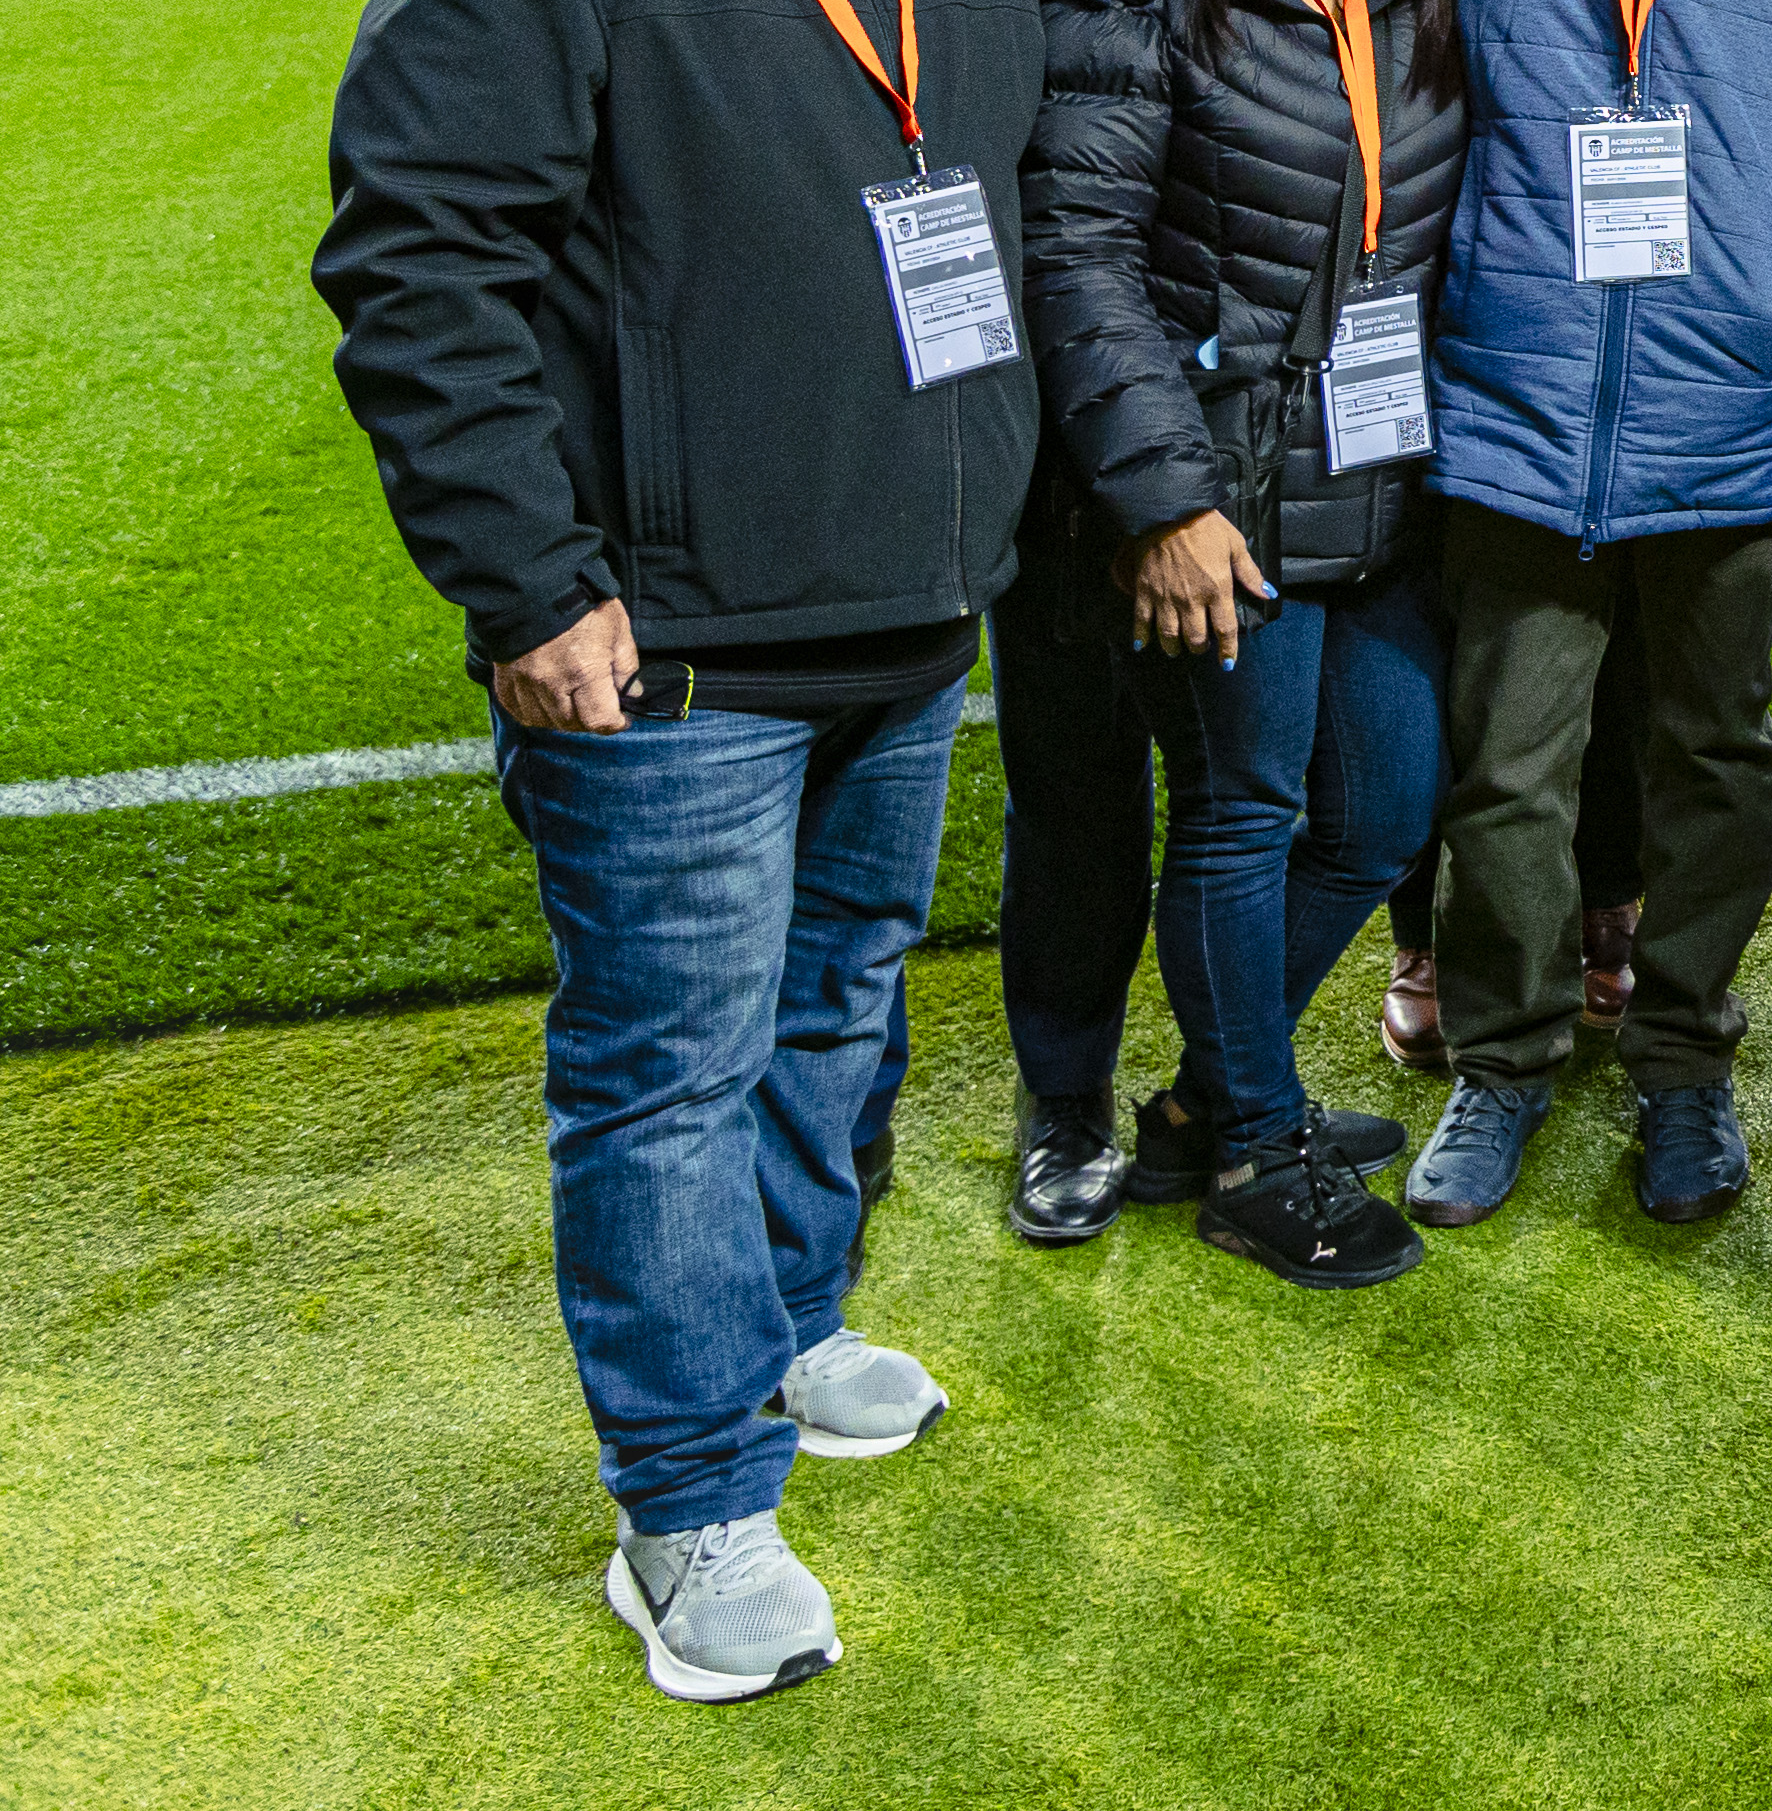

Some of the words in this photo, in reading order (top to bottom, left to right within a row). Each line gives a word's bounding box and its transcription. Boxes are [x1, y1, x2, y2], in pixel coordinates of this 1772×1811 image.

[1611, 147, 1633, 155] CAMP
[1634, 146, 1644, 154] DE
[1645, 144, 1682, 153] MESTALLA
[920, 221, 939, 232] CAMP
[940, 219, 950, 228] DE
[951, 210, 985, 226] MESTALLA
[1354, 327, 1373, 337] CAMP
[1374, 325, 1383, 333] DE
[1383, 319, 1417, 331] MESTALLA
